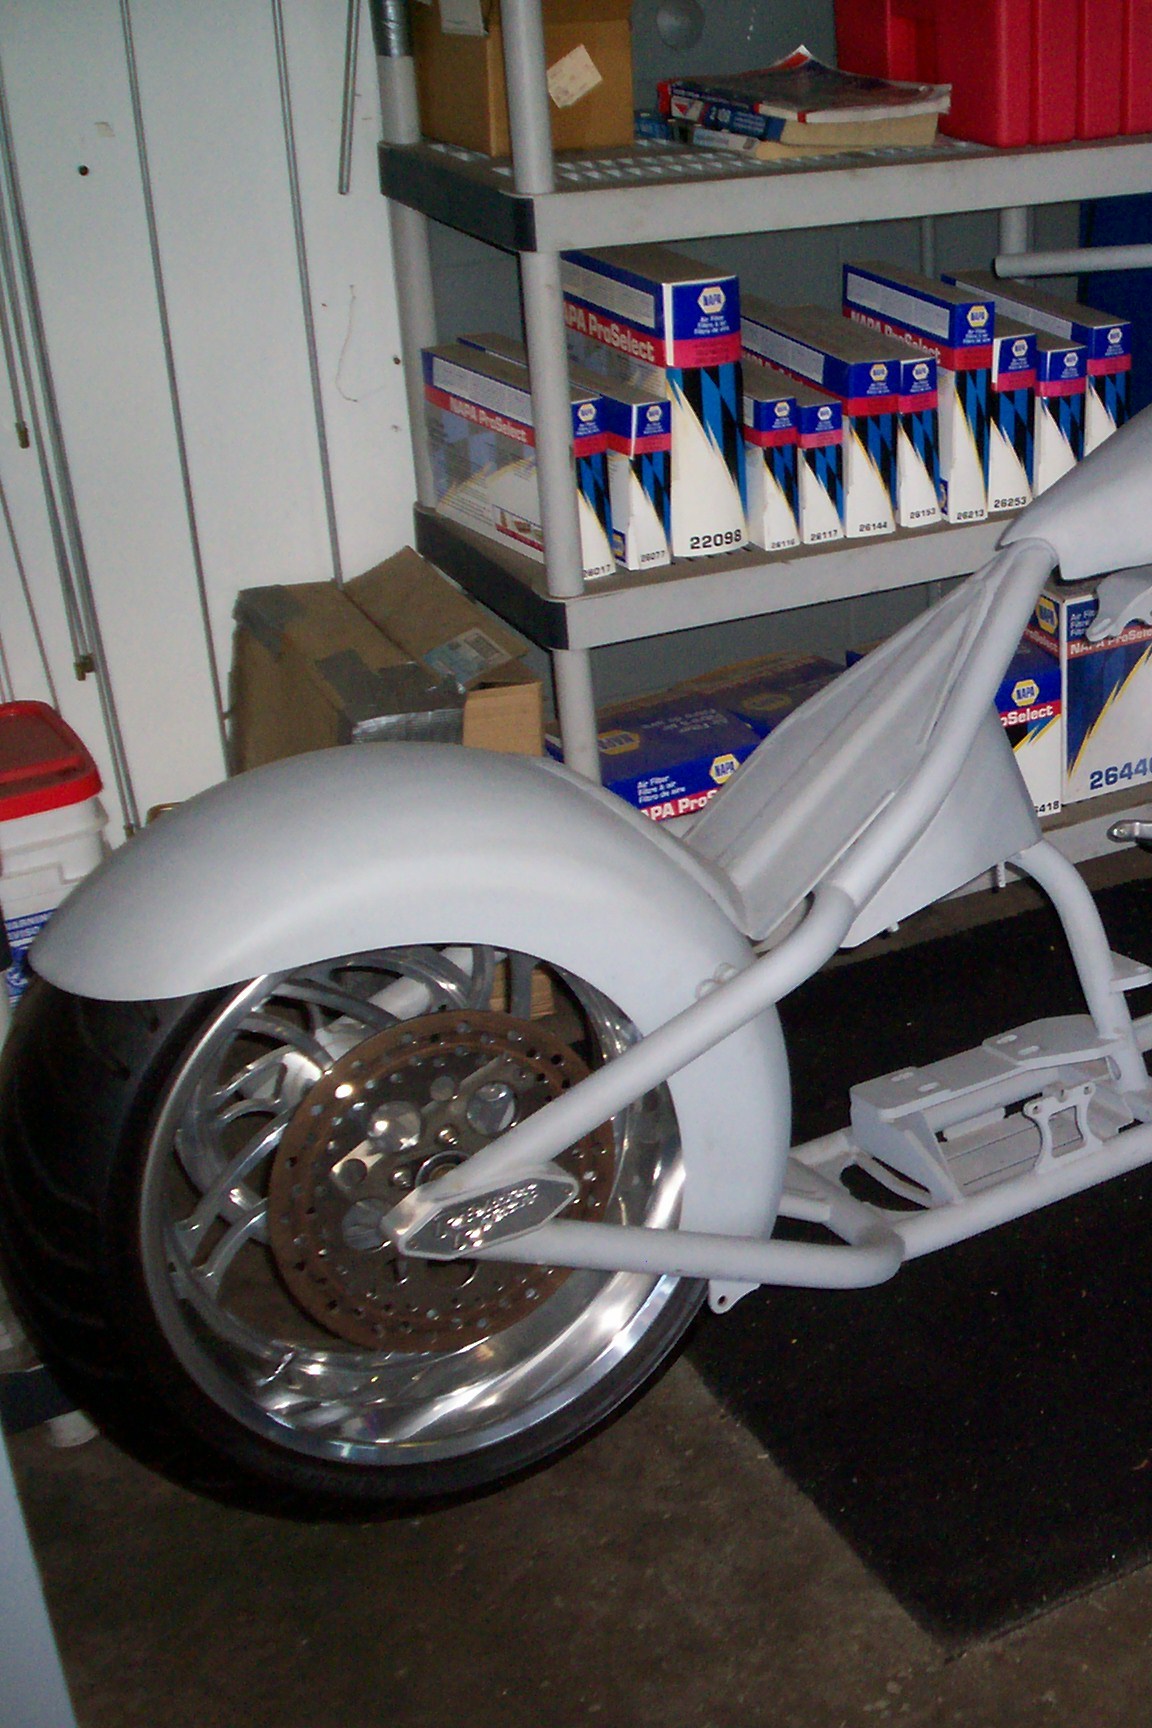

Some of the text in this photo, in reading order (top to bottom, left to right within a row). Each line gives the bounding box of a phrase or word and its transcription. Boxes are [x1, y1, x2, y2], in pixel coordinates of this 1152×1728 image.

[564, 301, 587, 332] APA
[588, 313, 656, 363] ProSelect
[993, 496, 1028, 509] 26253
[956, 508, 985, 520] 26213
[689, 528, 743, 550] 22098
[1001, 705, 1054, 727] oSelect
